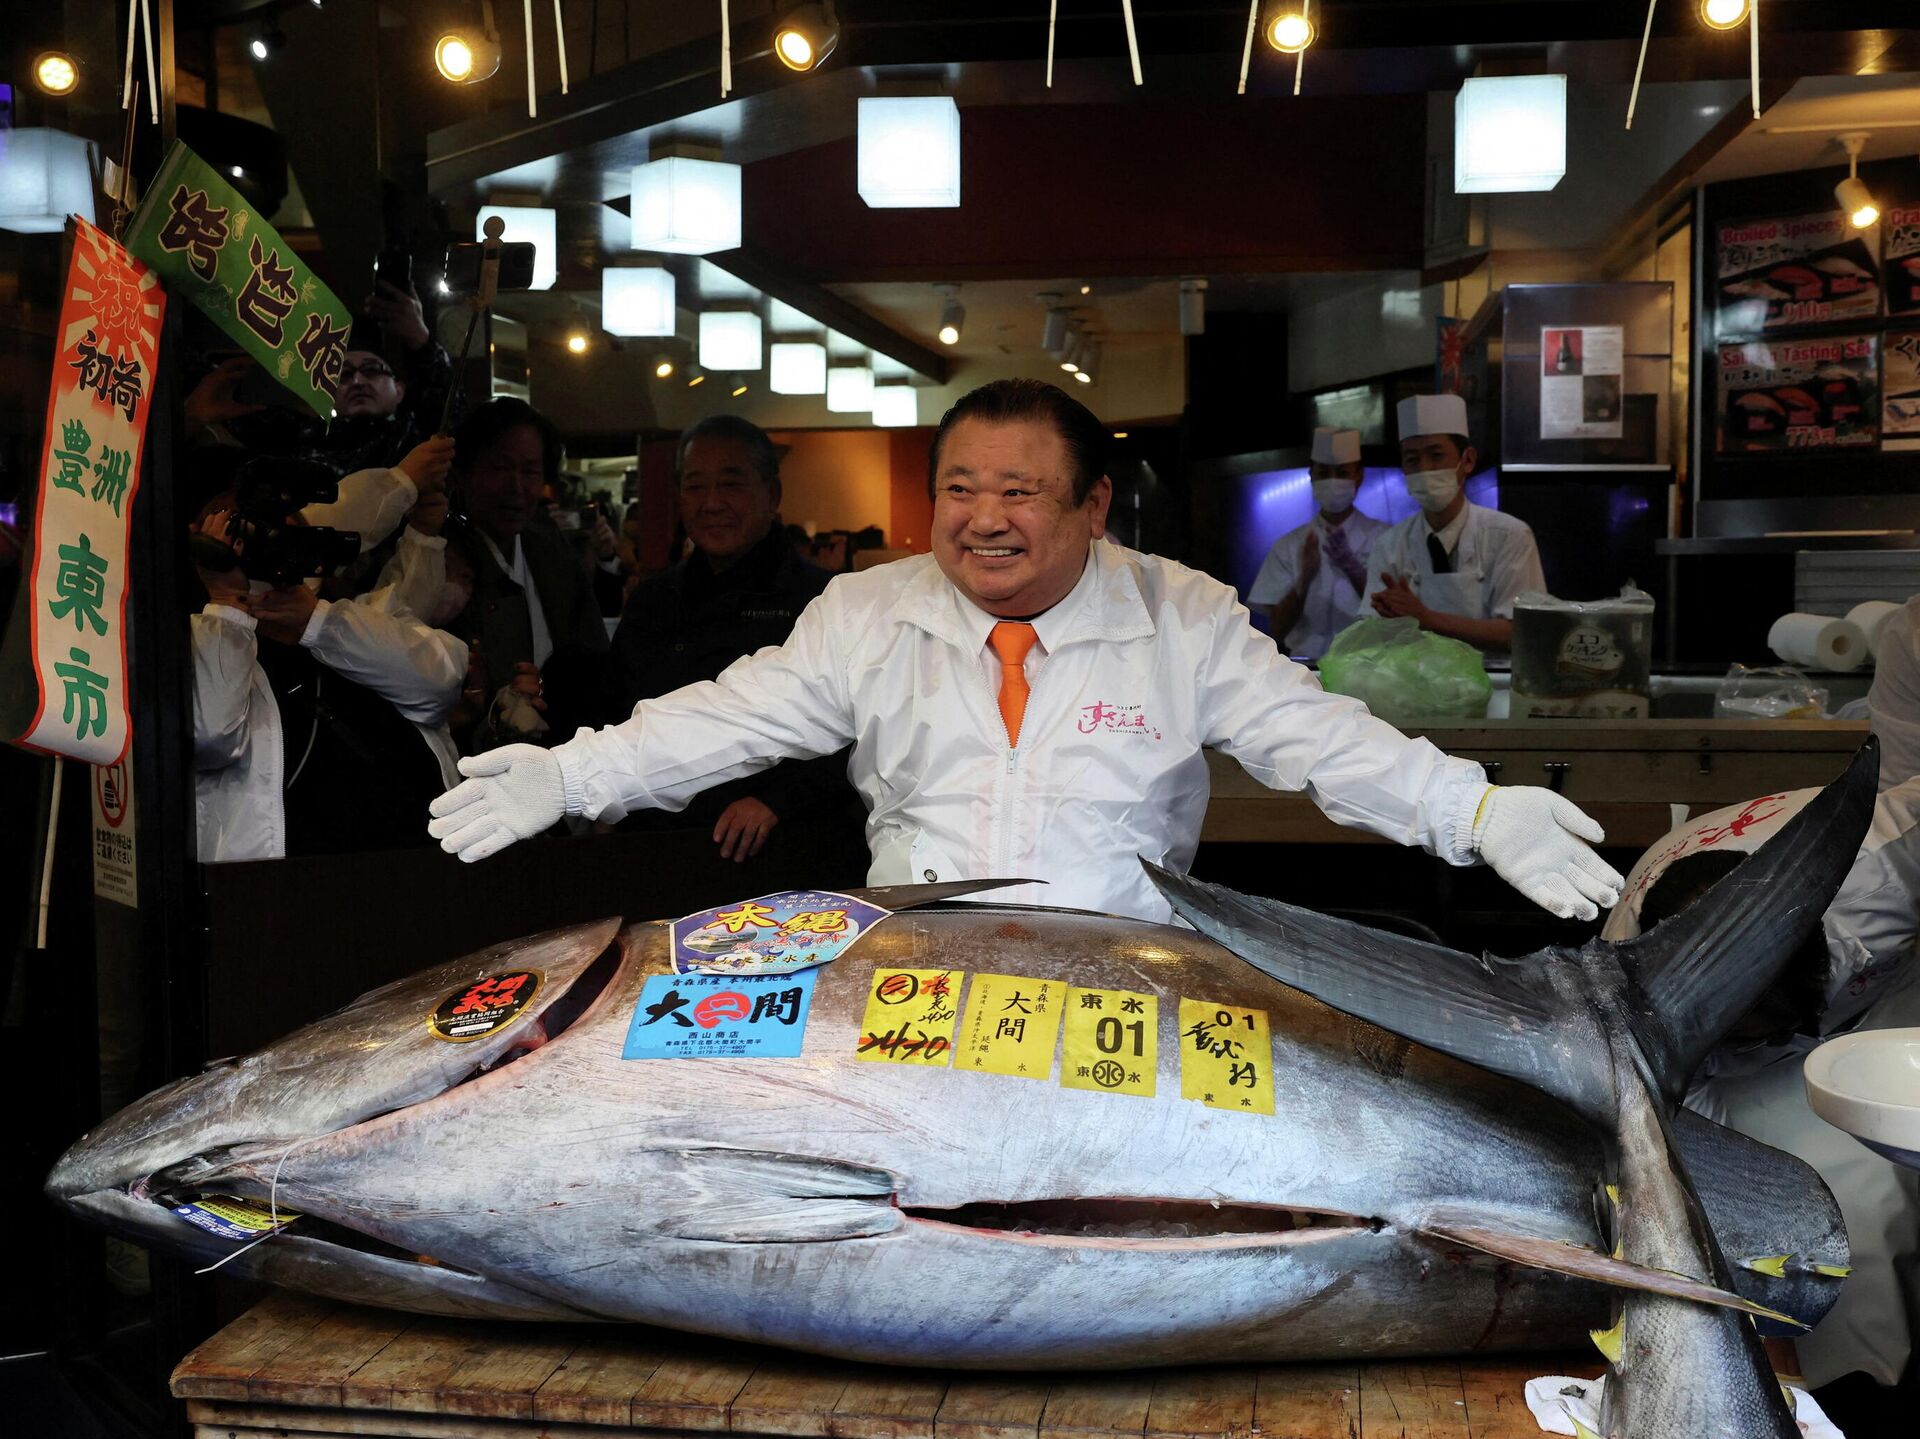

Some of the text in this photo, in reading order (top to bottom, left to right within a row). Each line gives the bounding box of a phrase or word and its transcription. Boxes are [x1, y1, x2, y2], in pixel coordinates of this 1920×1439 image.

[1723, 223, 1776, 244] Broiled
[89, 264, 141, 343] 祝
[1784, 346, 1841, 361] Tasting
[69, 329, 142, 423] 初荷
[52, 418, 131, 519] 豊洲
[995, 990, 1033, 1043] 大間
[1034, 983, 1051, 1013] 青森県
[1096, 1017, 1144, 1057] 01
[1215, 1010, 1255, 1031] 01
